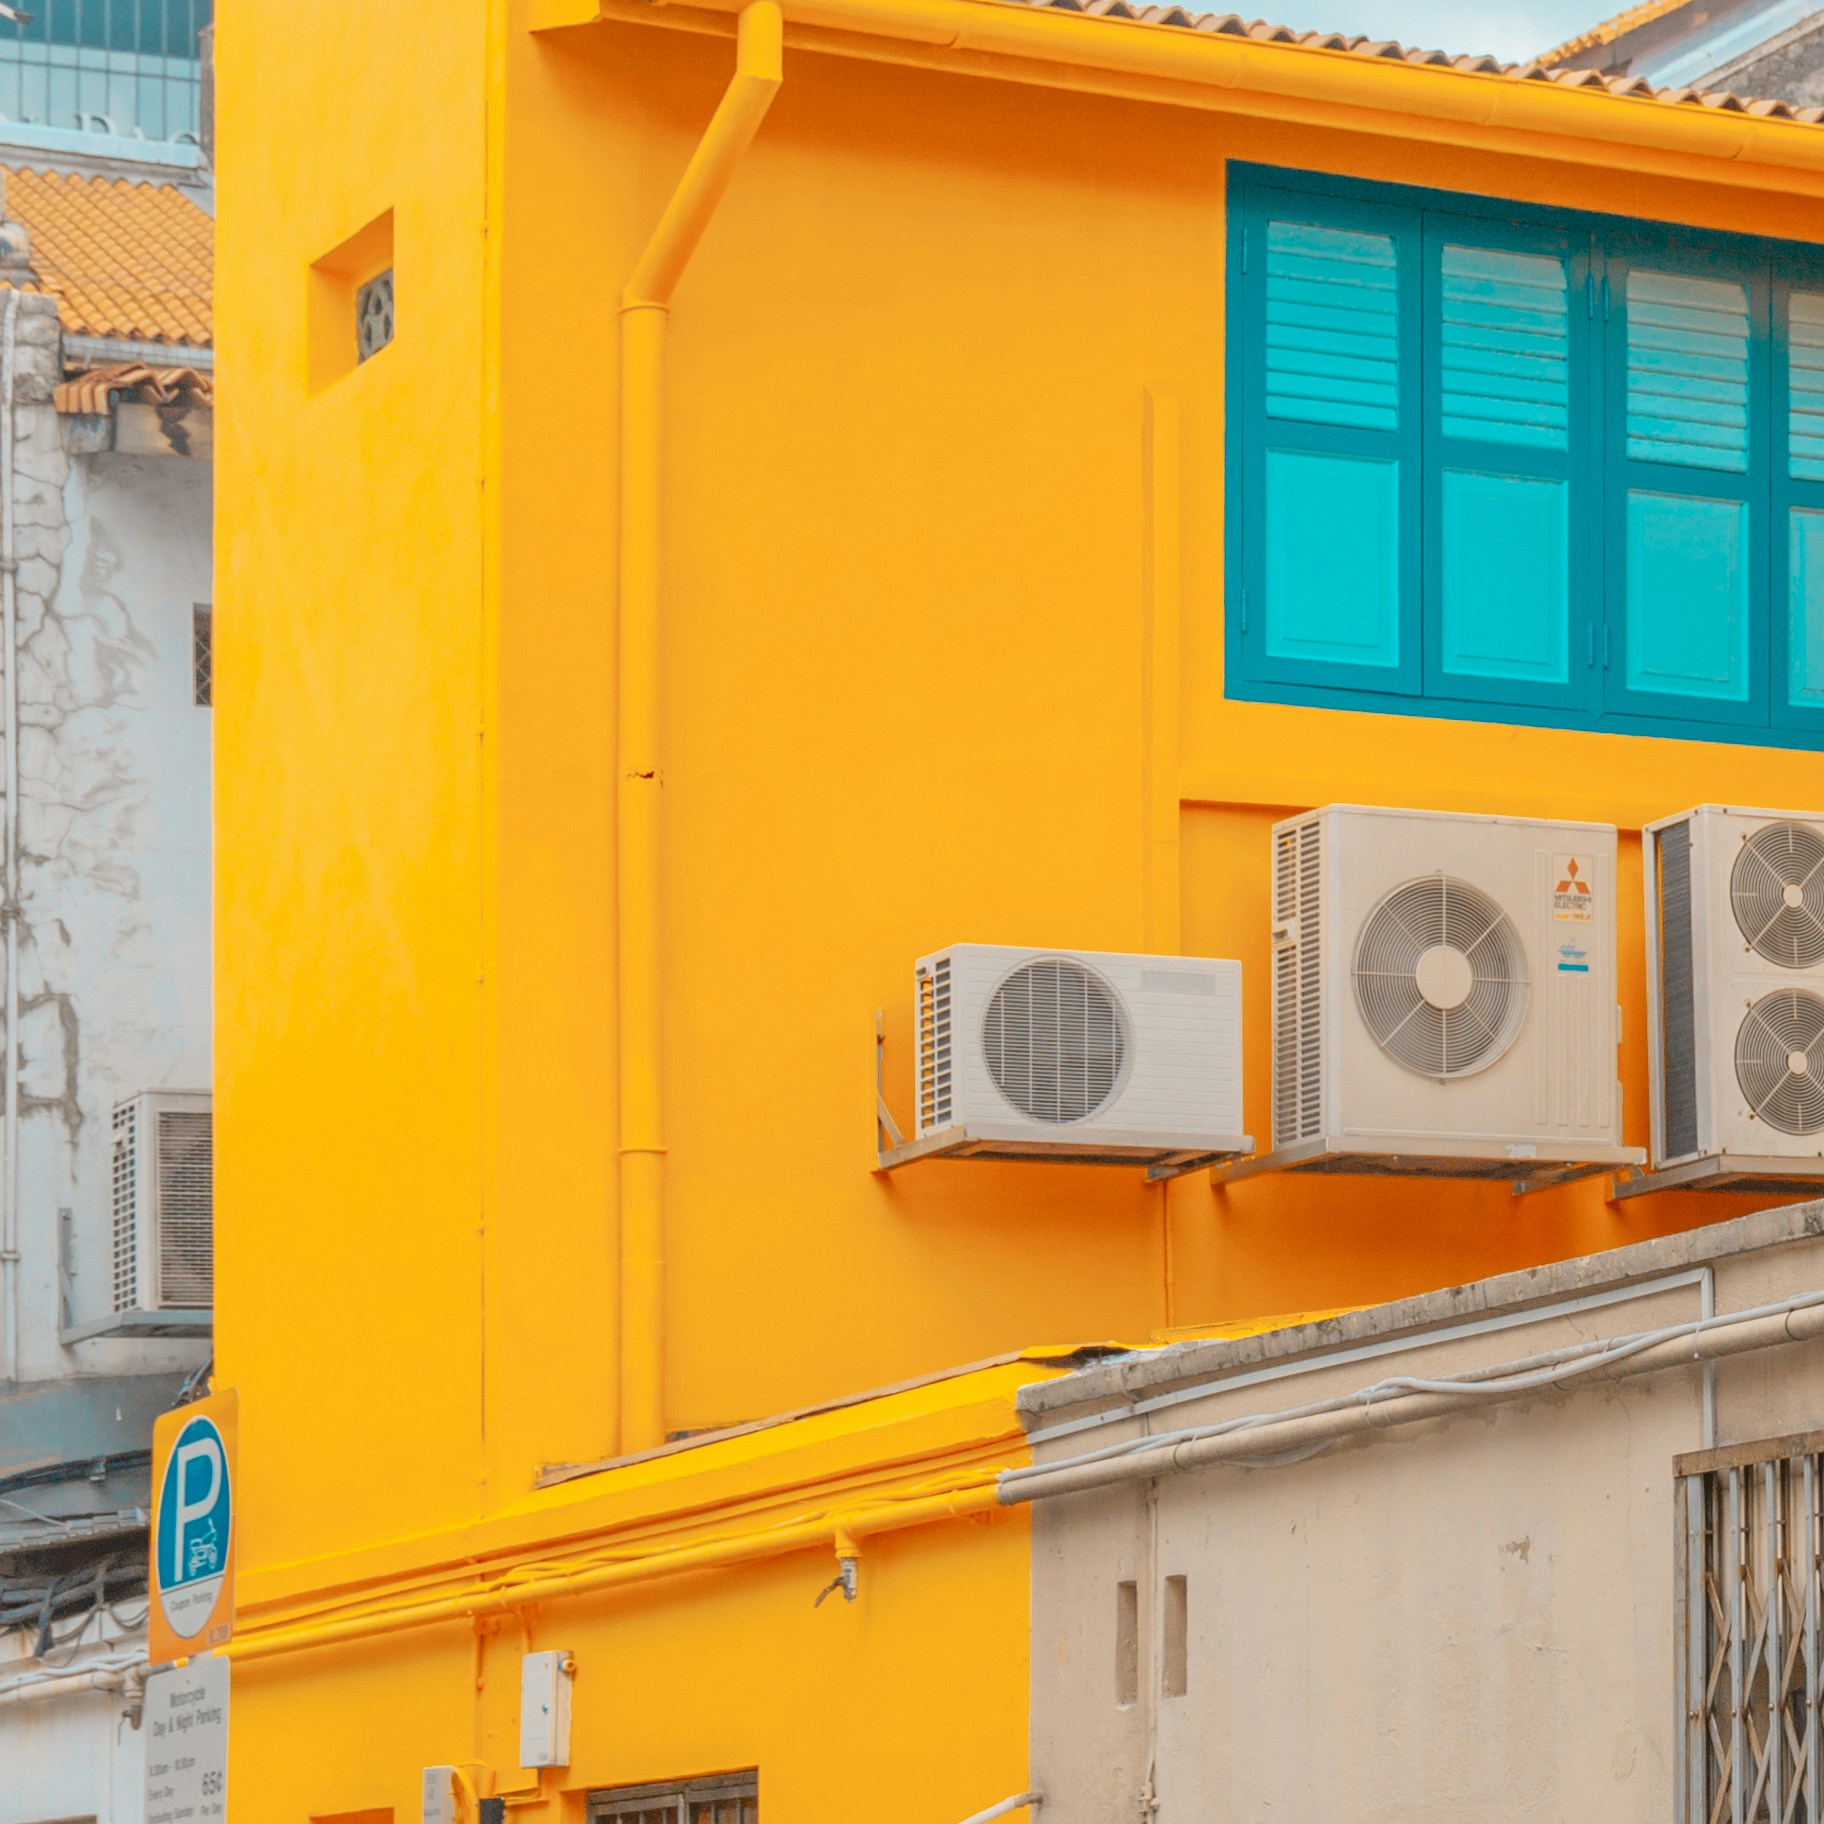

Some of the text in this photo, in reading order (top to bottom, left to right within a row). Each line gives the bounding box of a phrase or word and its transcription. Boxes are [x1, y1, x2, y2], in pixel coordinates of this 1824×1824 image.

[174, 1437, 222, 1583] P
[169, 1685, 206, 1709] Motorcycle
[153, 1720, 167, 1740] Day
[176, 1713, 194, 1733] Night
[196, 1707, 222, 1726] Parking
